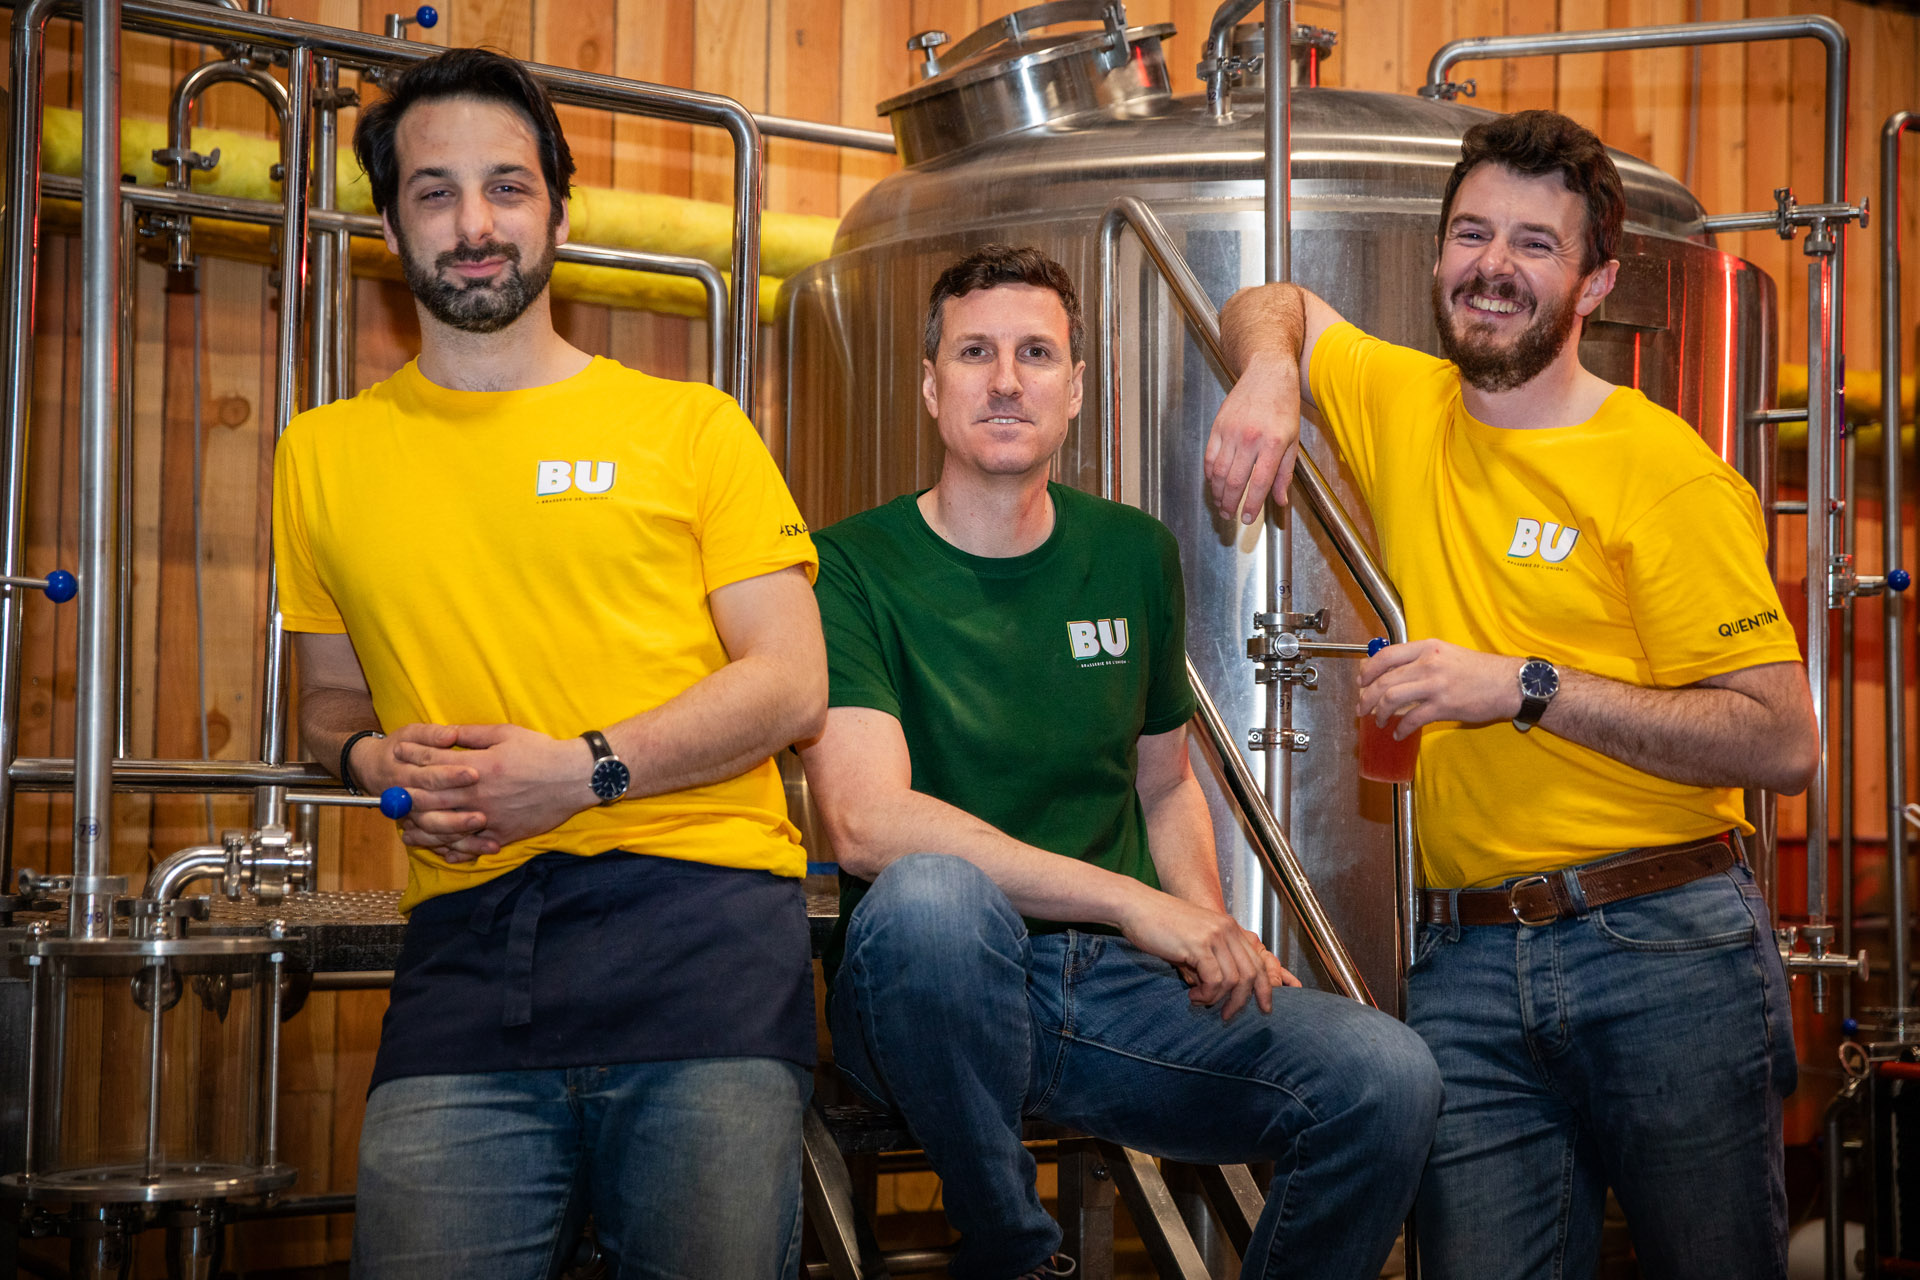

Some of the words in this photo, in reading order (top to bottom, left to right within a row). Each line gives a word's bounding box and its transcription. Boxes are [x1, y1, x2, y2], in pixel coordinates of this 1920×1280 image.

[536, 460, 616, 496] BU
[1506, 517, 1580, 563] BU
[1067, 617, 1130, 660] BU
[1718, 609, 1779, 637] QUENTIN
[84, 911, 104, 925] 78
